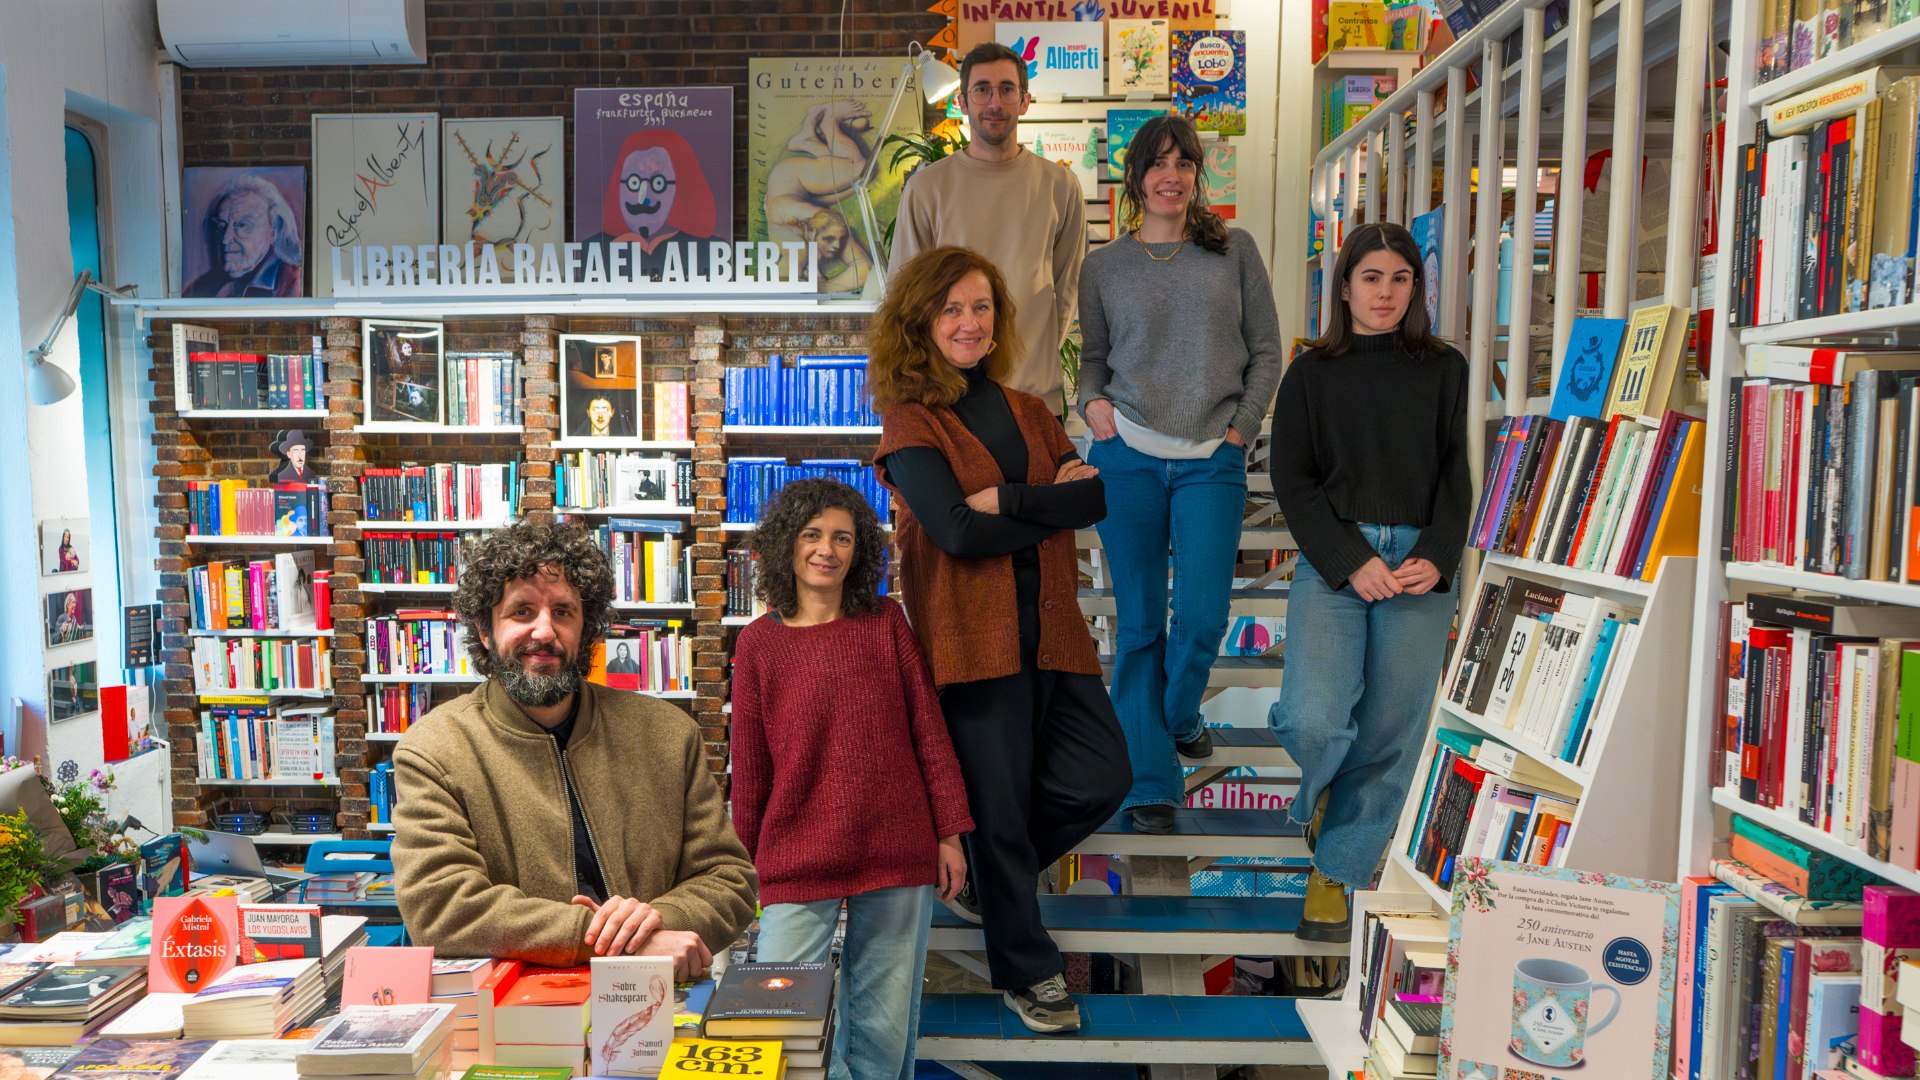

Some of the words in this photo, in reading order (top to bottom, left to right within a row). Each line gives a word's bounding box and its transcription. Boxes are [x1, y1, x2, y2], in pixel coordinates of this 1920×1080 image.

[962, 0, 1067, 22] INFANTIL
[1110, 0, 1212, 20] JUVENIL
[1338, 17, 1378, 25] Contrarios
[1046, 46, 1099, 69] Alberti
[756, 72, 916, 92] Gutenberg
[618, 91, 689, 112] españa
[332, 239, 497, 288] LIBRERÍA
[513, 241, 651, 286] RAFAEL
[661, 241, 818, 285] ALBERTI
[1725, 392, 1738, 442] GROSSMAN
[1724, 444, 1735, 471] VASILI
[616, 532, 624, 566] LOVING
[1524, 590, 1553, 603] Luciano
[1762, 655, 1774, 695] ALEXIÉVICH
[1771, 656, 1784, 697] ALEXIÉVICH
[1512, 885, 1527, 893] Estas
[1528, 888, 1560, 897] Navidades,
[1560, 893, 1579, 901] regala
[1579, 894, 1592, 902] Jane
[1515, 896, 1536, 904] compra
[1569, 902, 1592, 911] Victoria
[1599, 907, 1630, 917] regalamos
[1544, 907, 1590, 918] conmemorativa
[1590, 912, 1600, 920] del
[180, 915, 213, 923] Gabriela
[182, 922, 210, 931] Mistral
[248, 914, 266, 923] JUAN
[266, 914, 299, 923] MAYORGA
[248, 925, 261, 934] LOS
[261, 925, 308, 935] YUGOSLAVOS
[1517, 918, 1541, 931] 250
[1541, 924, 1594, 940] aniversario
[162, 935, 227, 958] Éxtasis
[1516, 933, 1526, 942] de
[1526, 933, 1551, 946] JANE
[1553, 938, 1592, 952] AUSTEN
[1615, 956, 1640, 965] AGOTAR
[1617, 950, 1637, 958] HASTA
[1608, 961, 1646, 973] EXISTENCIAS
[612, 982, 636, 991] Sobre
[598, 993, 648, 1004] Shakespeare
[638, 1039, 663, 1048] Samuel
[631, 1049, 658, 1058] Johnson
[679, 1044, 763, 1063] 163
[675, 1059, 764, 1075] cm.
